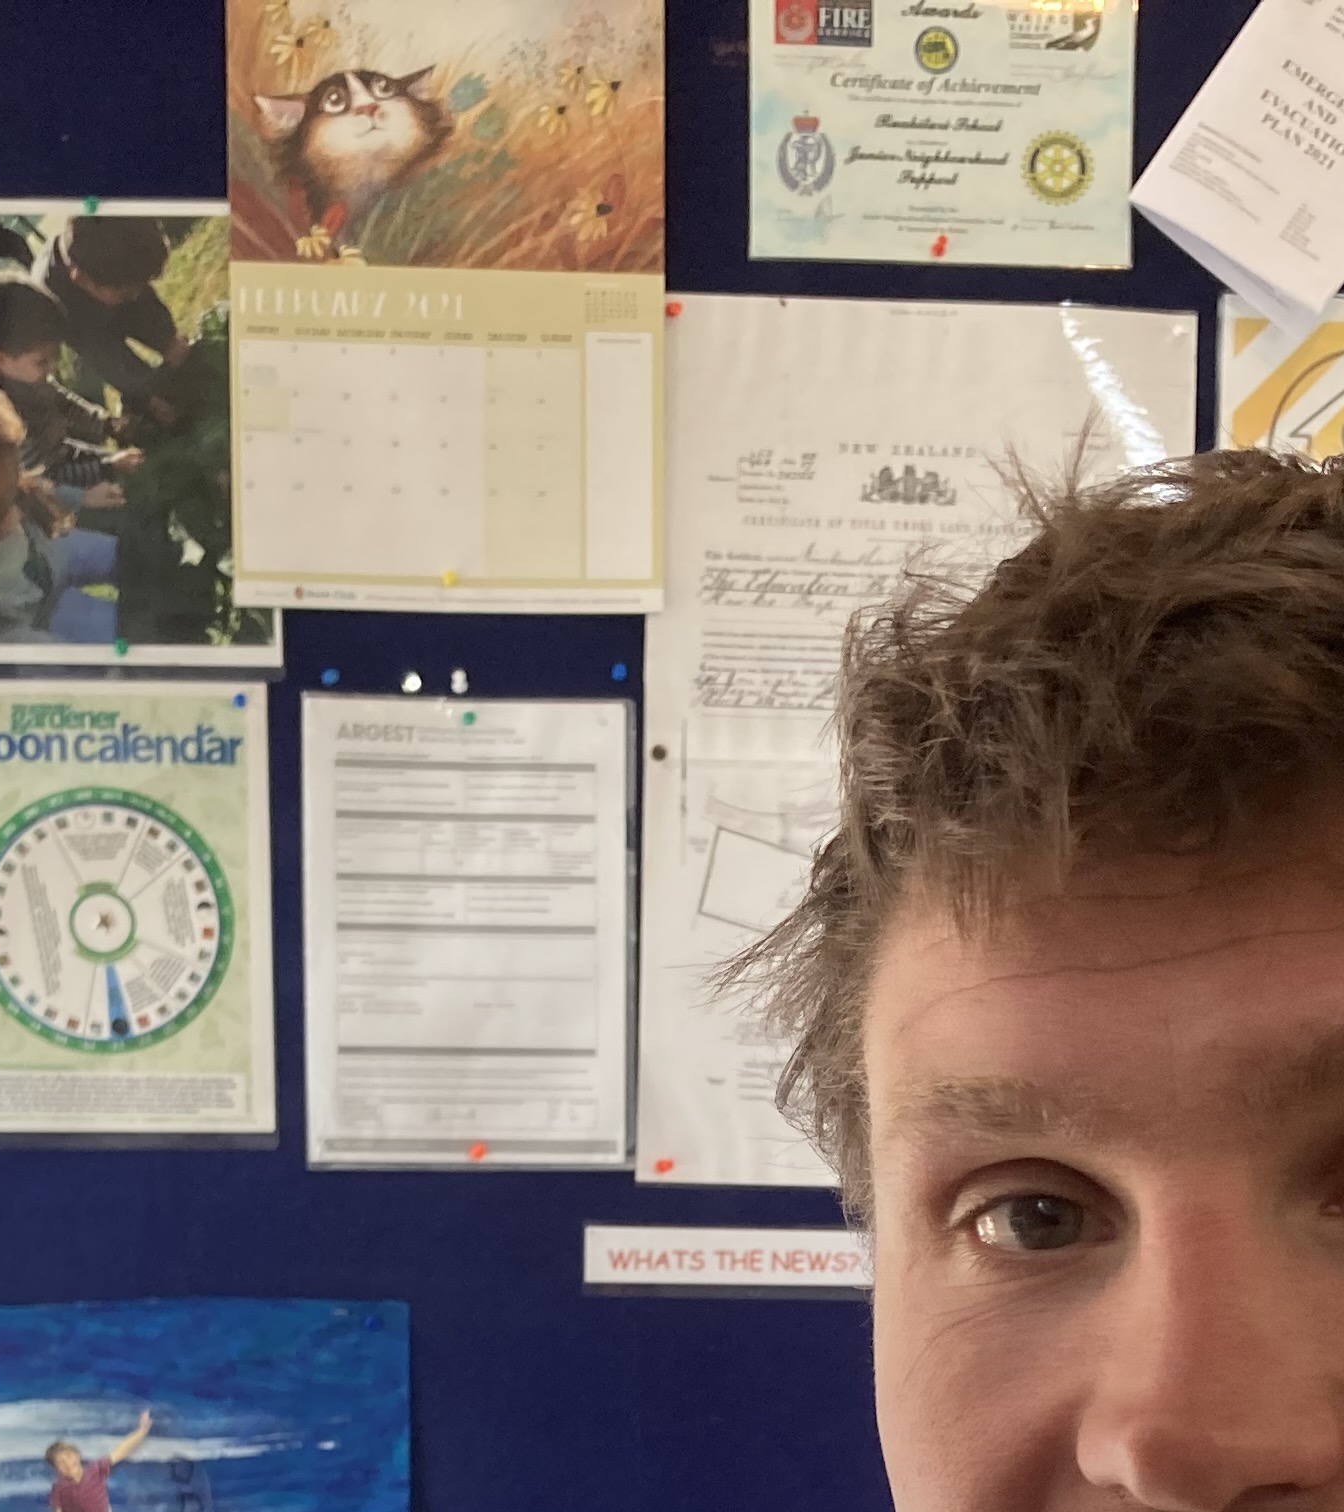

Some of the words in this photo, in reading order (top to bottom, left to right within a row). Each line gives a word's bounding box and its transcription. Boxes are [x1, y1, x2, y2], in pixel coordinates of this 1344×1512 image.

[819, 7, 870, 28] FIRE
[830, 72, 913, 92] Certificate
[916, 76, 936, 96] of
[937, 77, 1042, 96] Achievement
[1302, 99, 1337, 125] AND
[1261, 112, 1302, 147] PLAN
[1304, 143, 1335, 170] 2021
[72, 722, 243, 767] calendar
[607, 1248, 705, 1272] WHATS
[712, 1249, 765, 1272] THE
